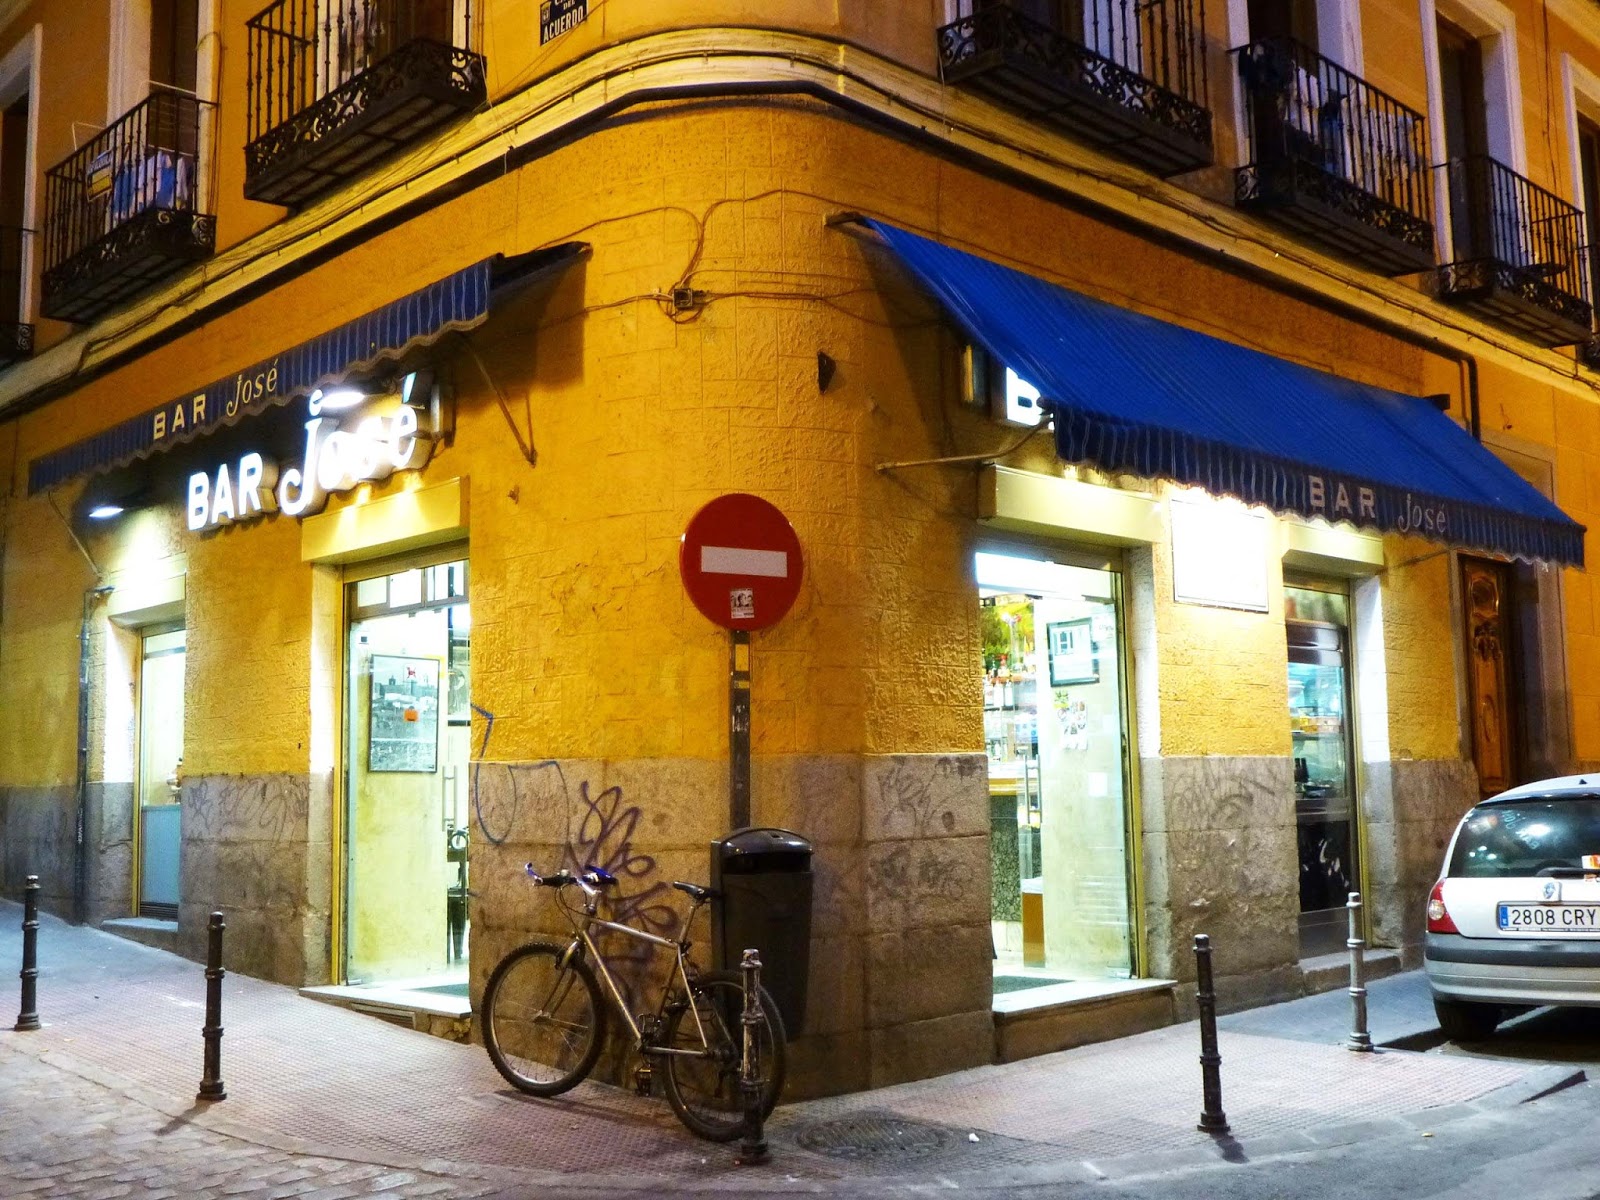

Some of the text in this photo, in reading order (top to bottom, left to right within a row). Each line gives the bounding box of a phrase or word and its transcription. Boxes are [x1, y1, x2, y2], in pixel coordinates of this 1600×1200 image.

[543, 5, 584, 44] ACUERDO
[153, 393, 207, 440] BAR
[188, 452, 264, 532] BAR
[1308, 474, 1376, 519] BAR
[1511, 908, 1556, 926] 2808
[1562, 908, 1597, 926] CRY
